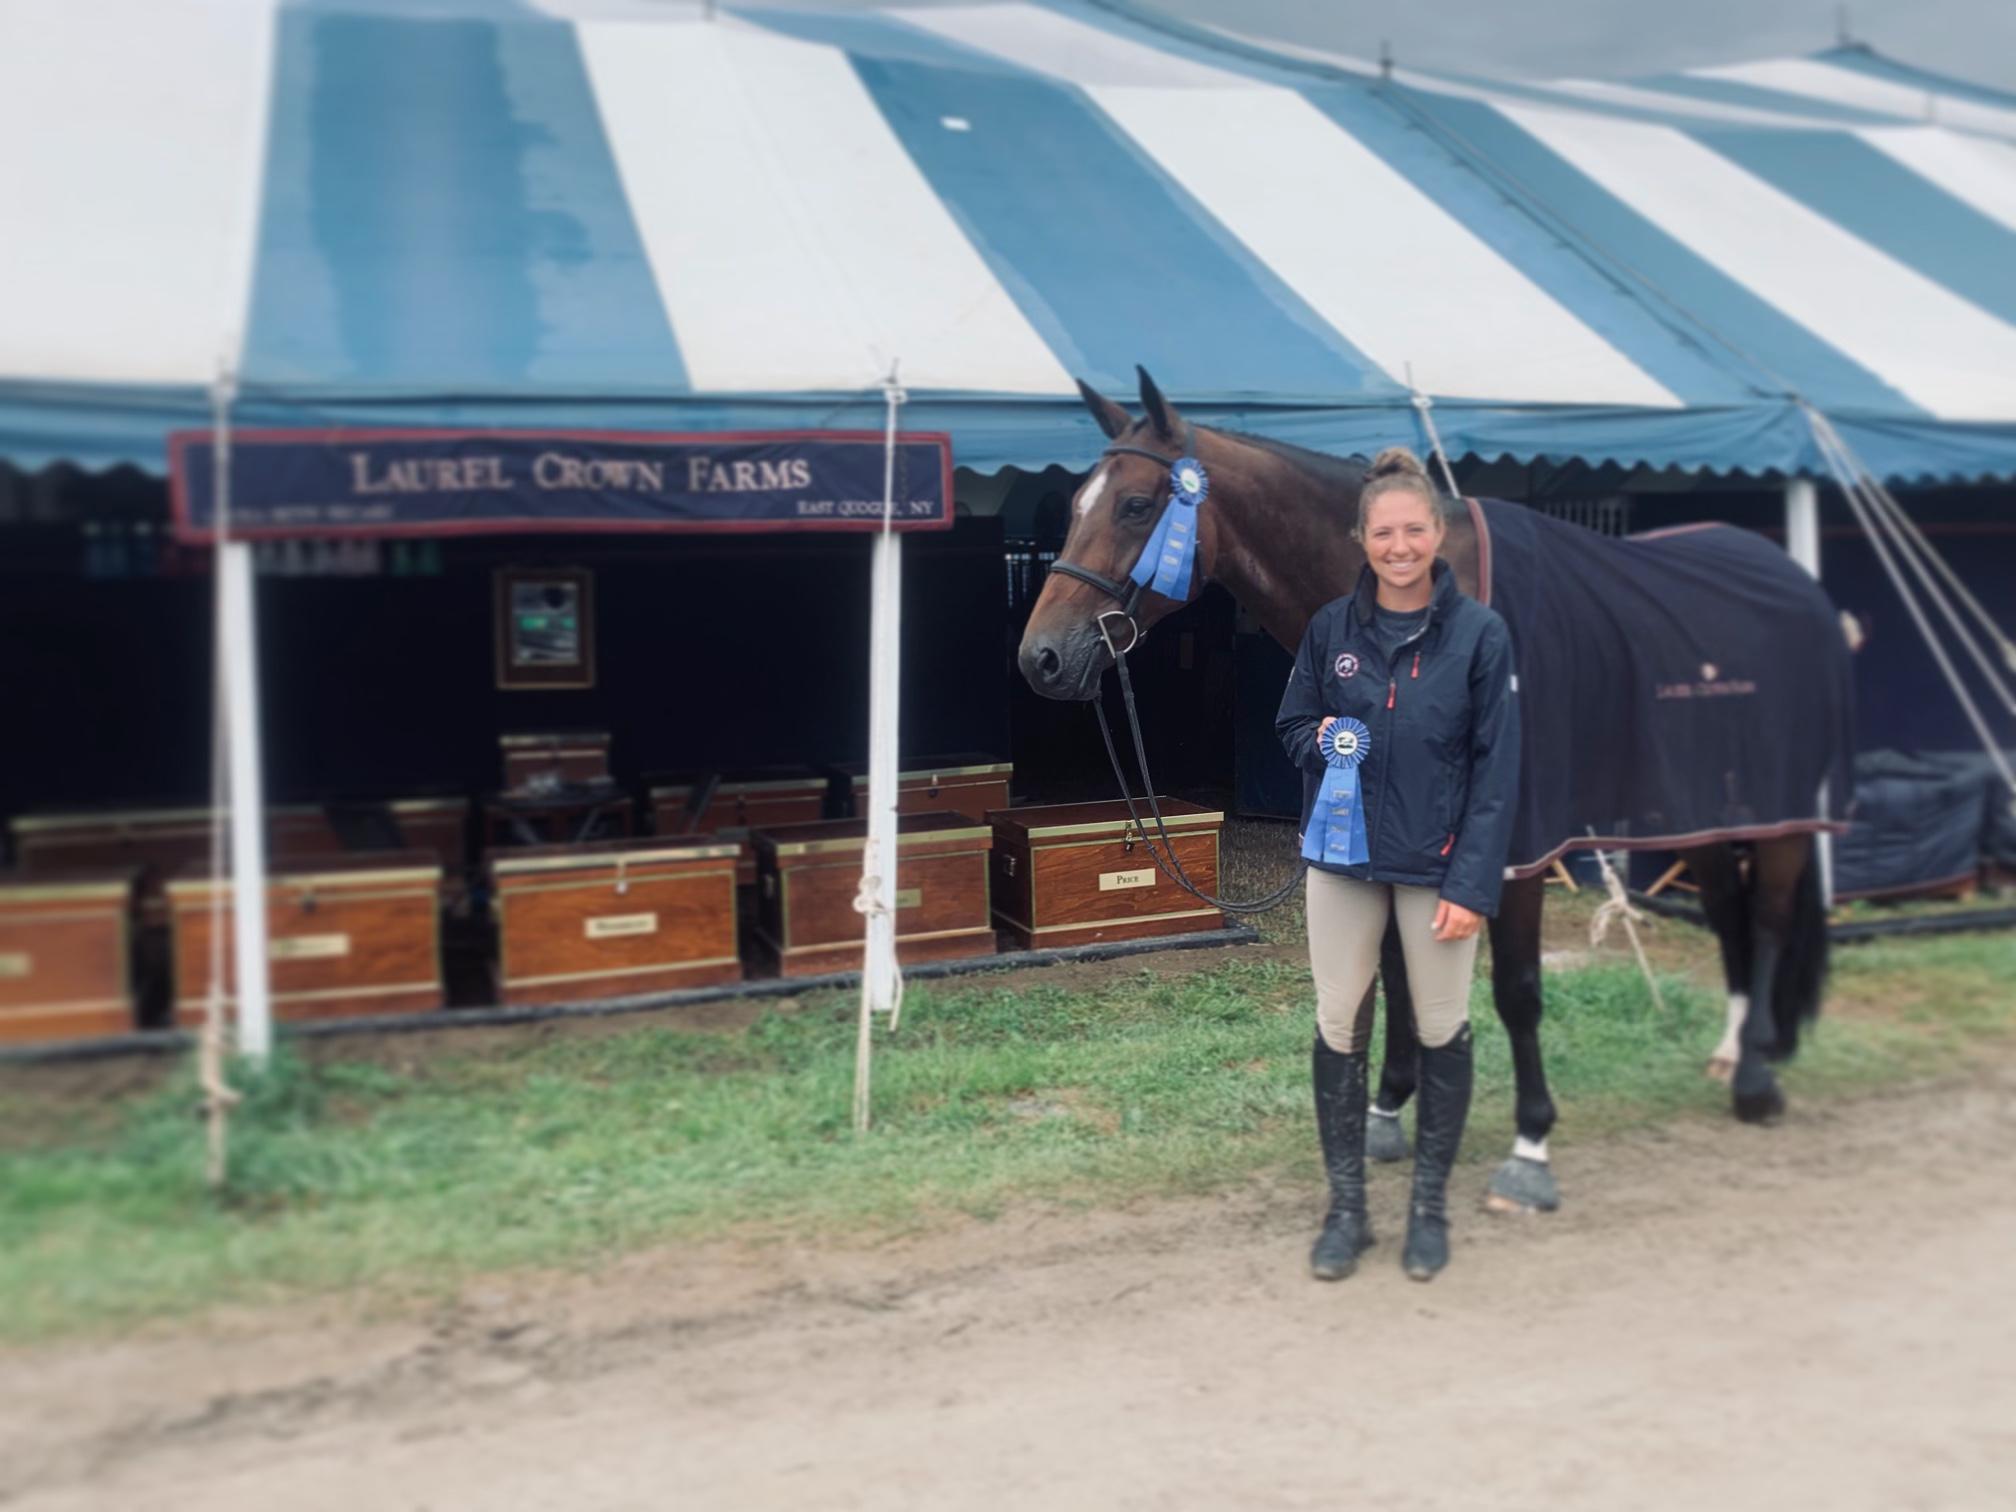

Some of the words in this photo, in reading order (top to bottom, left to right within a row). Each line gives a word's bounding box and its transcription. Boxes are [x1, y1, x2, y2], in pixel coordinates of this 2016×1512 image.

[351, 453, 513, 494] LAUREL
[533, 452, 664, 491] CROWN
[688, 457, 811, 491] FARMS
[797, 500, 833, 514] EAST
[909, 500, 934, 514] NY
